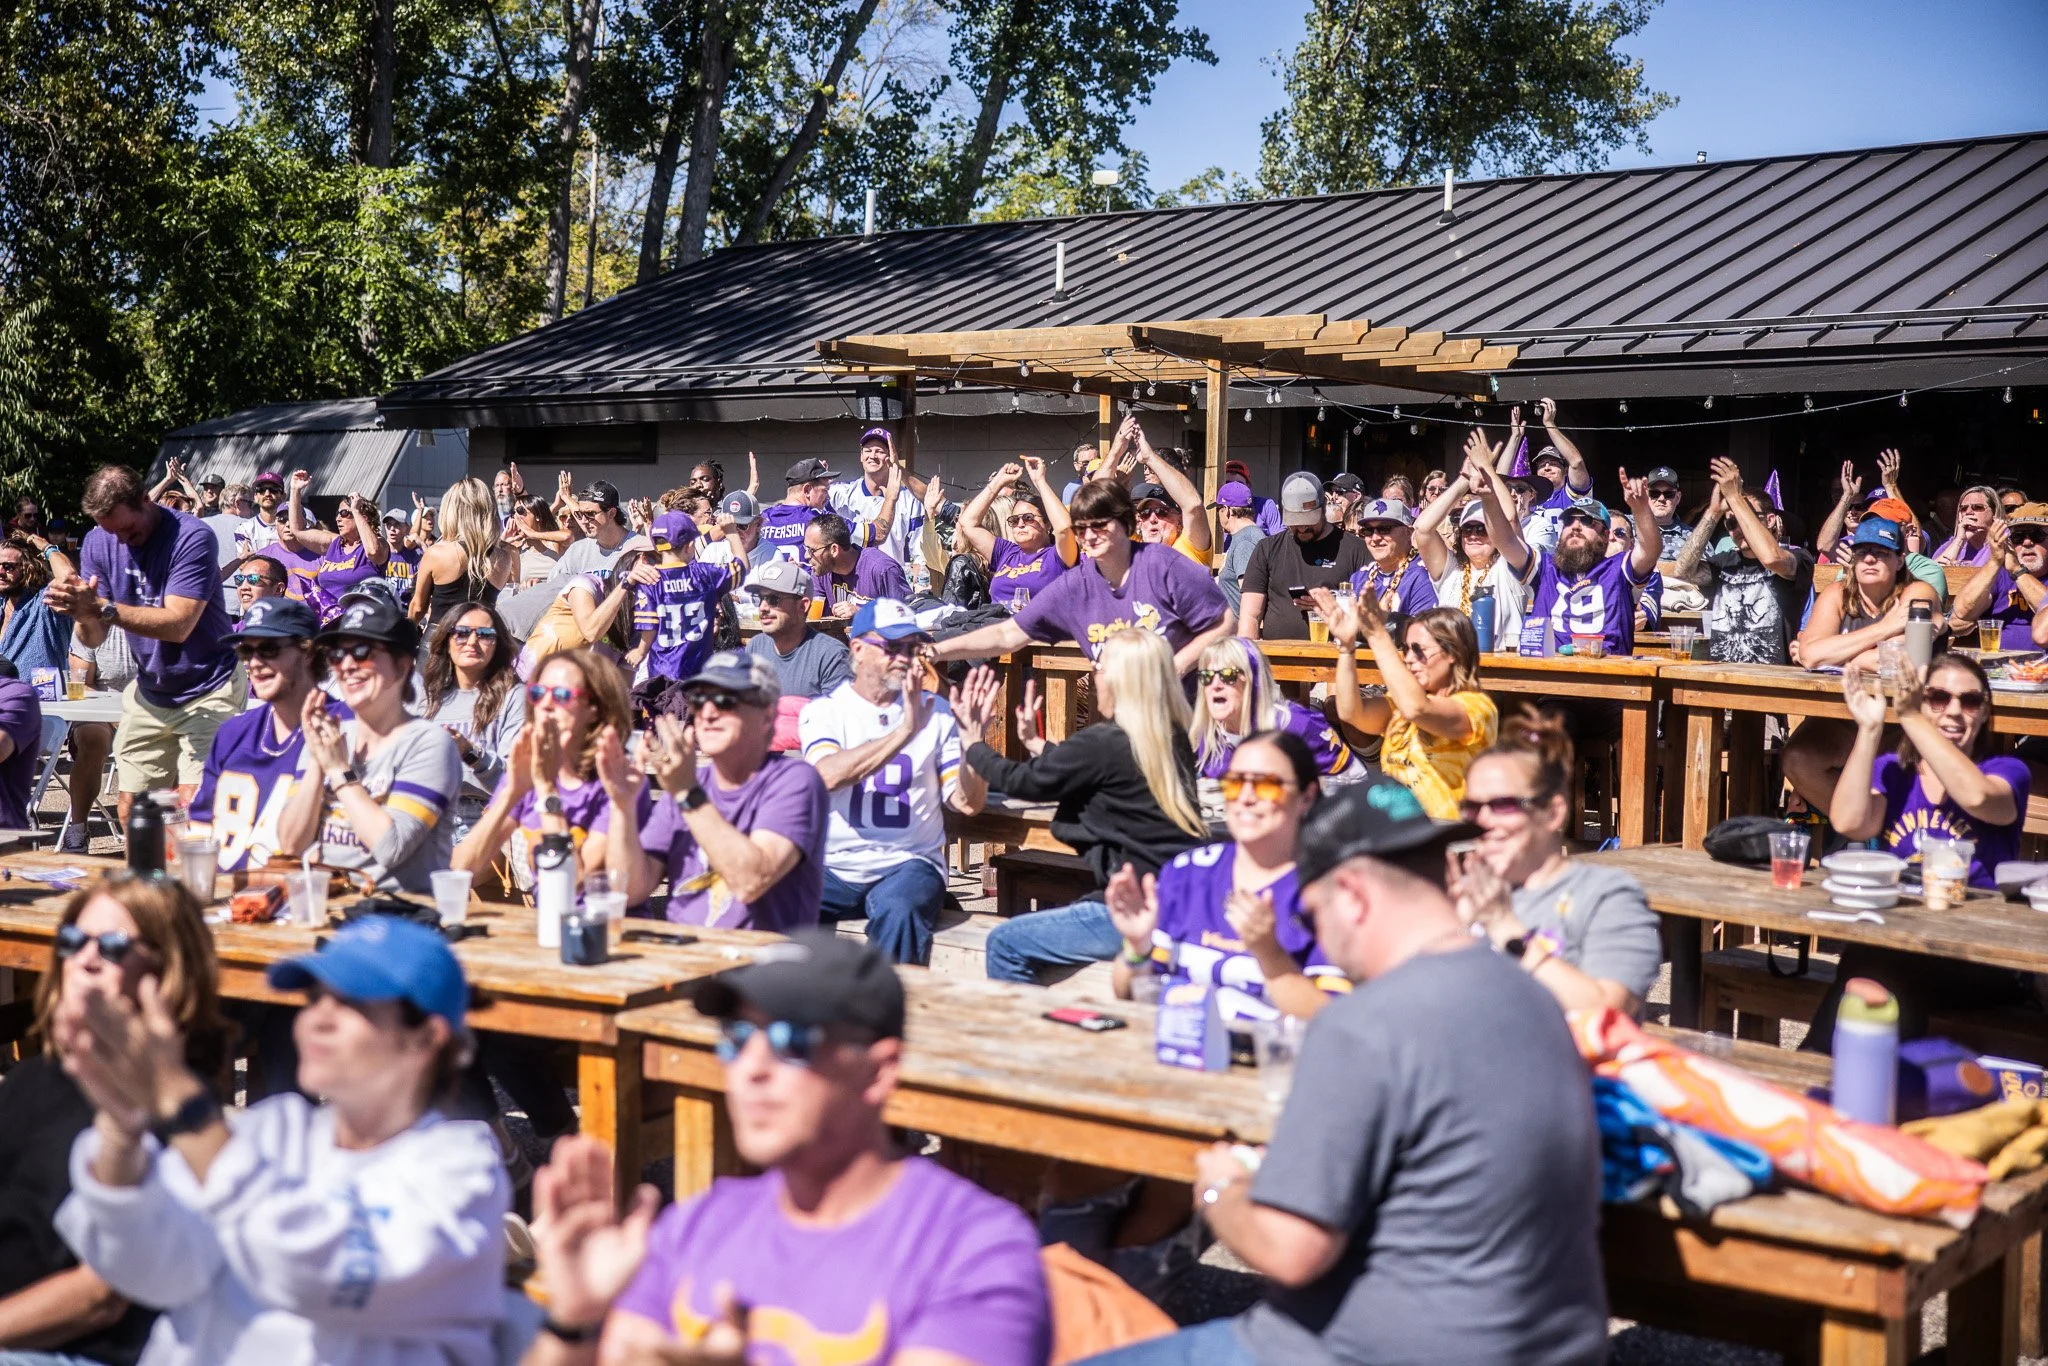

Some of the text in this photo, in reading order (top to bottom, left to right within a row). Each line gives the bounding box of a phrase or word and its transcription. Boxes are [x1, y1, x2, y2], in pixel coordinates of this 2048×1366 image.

[761, 523, 805, 539] EFFERSON
[386, 561, 415, 579] KOL
[663, 578, 693, 592] COOK
[656, 601, 708, 648] 33
[1551, 581, 1606, 634] 19
[849, 754, 913, 829] 18
[1884, 808, 1973, 847] MINNESOT
